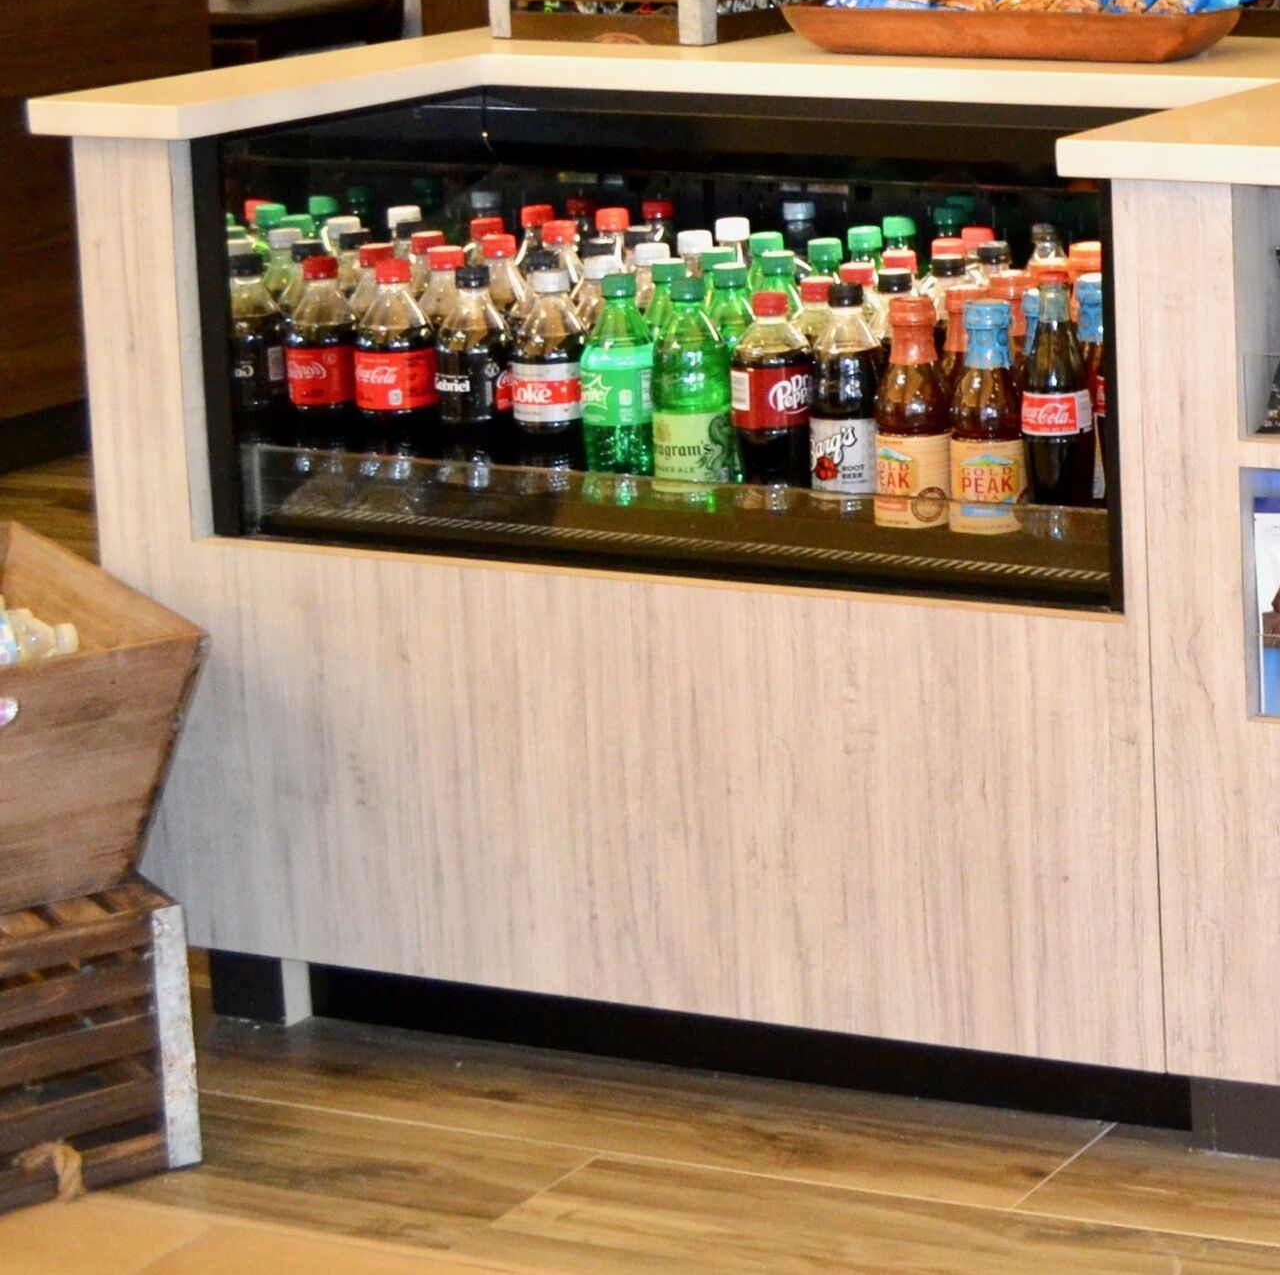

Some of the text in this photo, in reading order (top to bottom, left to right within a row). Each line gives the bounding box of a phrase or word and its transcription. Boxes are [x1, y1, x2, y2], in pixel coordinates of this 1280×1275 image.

[769, 379, 809, 412] Pepp
[655, 441, 712, 458] agram's
[878, 461, 909, 473] OLD
[962, 467, 1013, 478] GOLD
[878, 472, 911, 490] EAK
[961, 476, 1014, 494] PEAK
